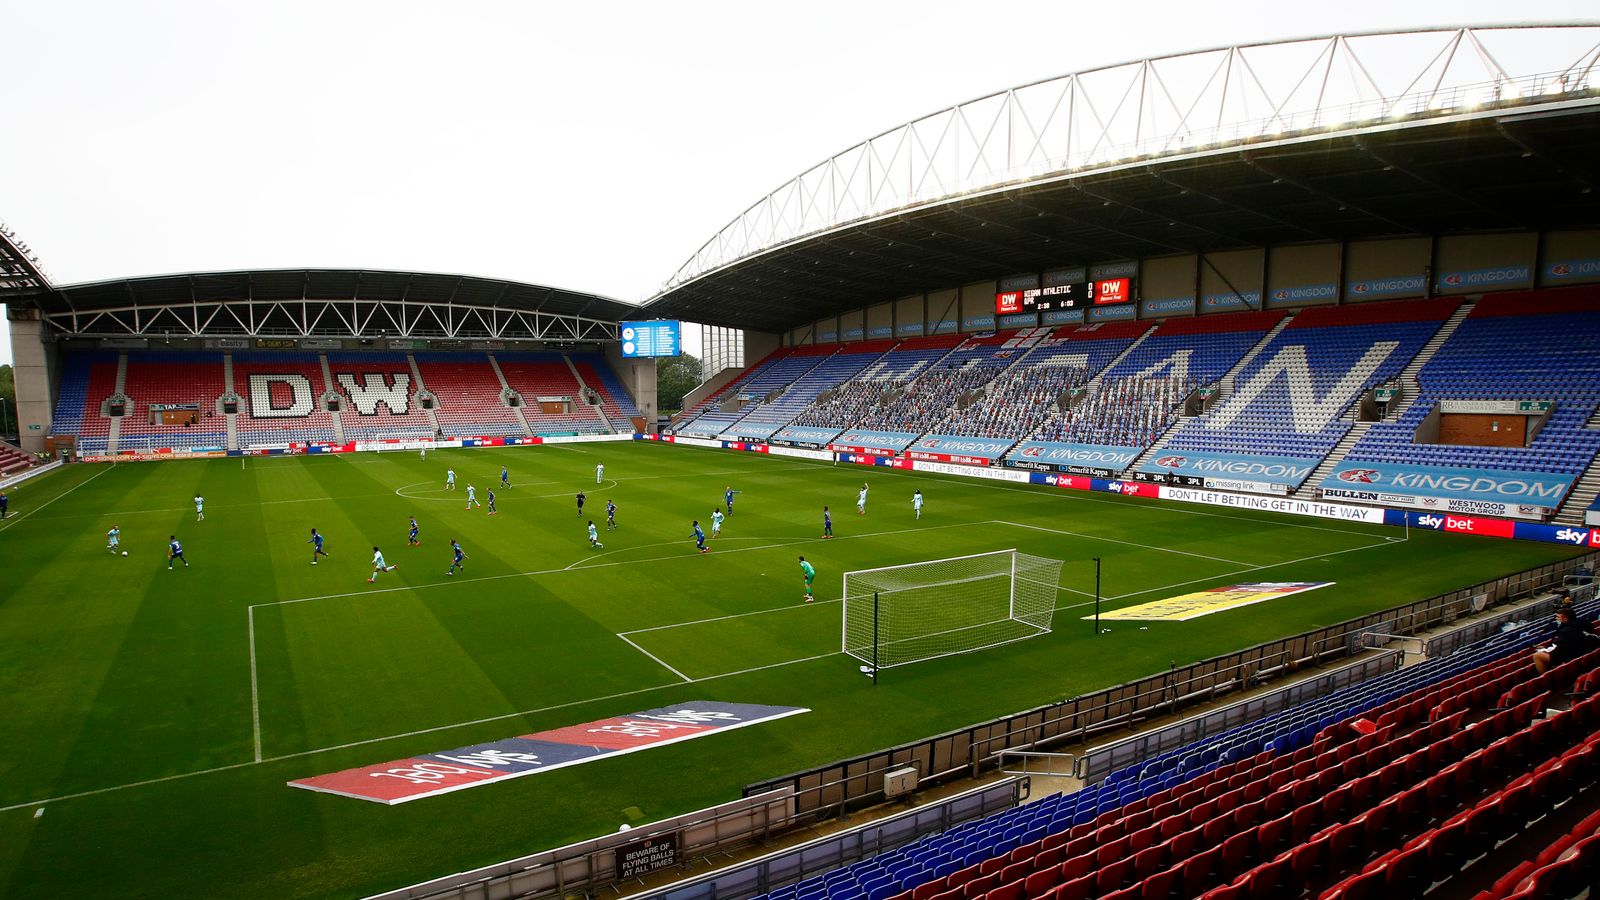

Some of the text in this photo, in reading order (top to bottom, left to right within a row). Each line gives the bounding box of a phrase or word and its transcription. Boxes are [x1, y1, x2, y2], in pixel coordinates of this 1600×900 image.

[1468, 268, 1528, 282] KINGDOM
[1024, 285, 1071, 297] WIGAN ATHLETIC
[1102, 281, 1120, 294] DW
[1372, 278, 1424, 292] KINGDOM
[1292, 286, 1336, 298] KINGDOM
[1002, 294, 1016, 305] DW
[1160, 299, 1194, 309] KINGDOM
[1221, 293, 1260, 304] KINGDOM
[1104, 307, 1135, 315] KINGDOM
[861, 435, 910, 446] KINGDOM
[943, 441, 1008, 453] KINGDOM
[1048, 449, 1136, 464] KINGDOM
[1015, 460, 1034, 469] Smurfit
[1192, 458, 1314, 479] KINGDOM
[918, 462, 934, 470] DON'T
[947, 465, 971, 475] BETTING
[972, 468, 984, 476] GET
[994, 470, 1006, 478] THE
[1007, 471, 1022, 480] WAY
[1068, 466, 1108, 477] Smurfit Kappa
[1046, 476, 1072, 486] sky bet
[1215, 480, 1240, 490] missing
[1391, 472, 1567, 498] KINGDOM
[1108, 482, 1139, 493] sky bet
[1324, 488, 1379, 500] BULLEN
[1169, 489, 1368, 519] DON'T LET BETTING GET IN THE WAY
[1449, 500, 1505, 511] WESTWOOD
[1477, 507, 1505, 515] GROUP
[1418, 514, 1473, 531] sky bet
[1556, 528, 1588, 544] sky
[626, 842, 670, 861] BEWARE OF
[623, 850, 674, 870] FLYING BALLS
[624, 858, 673, 878] AT ALL TIMES
